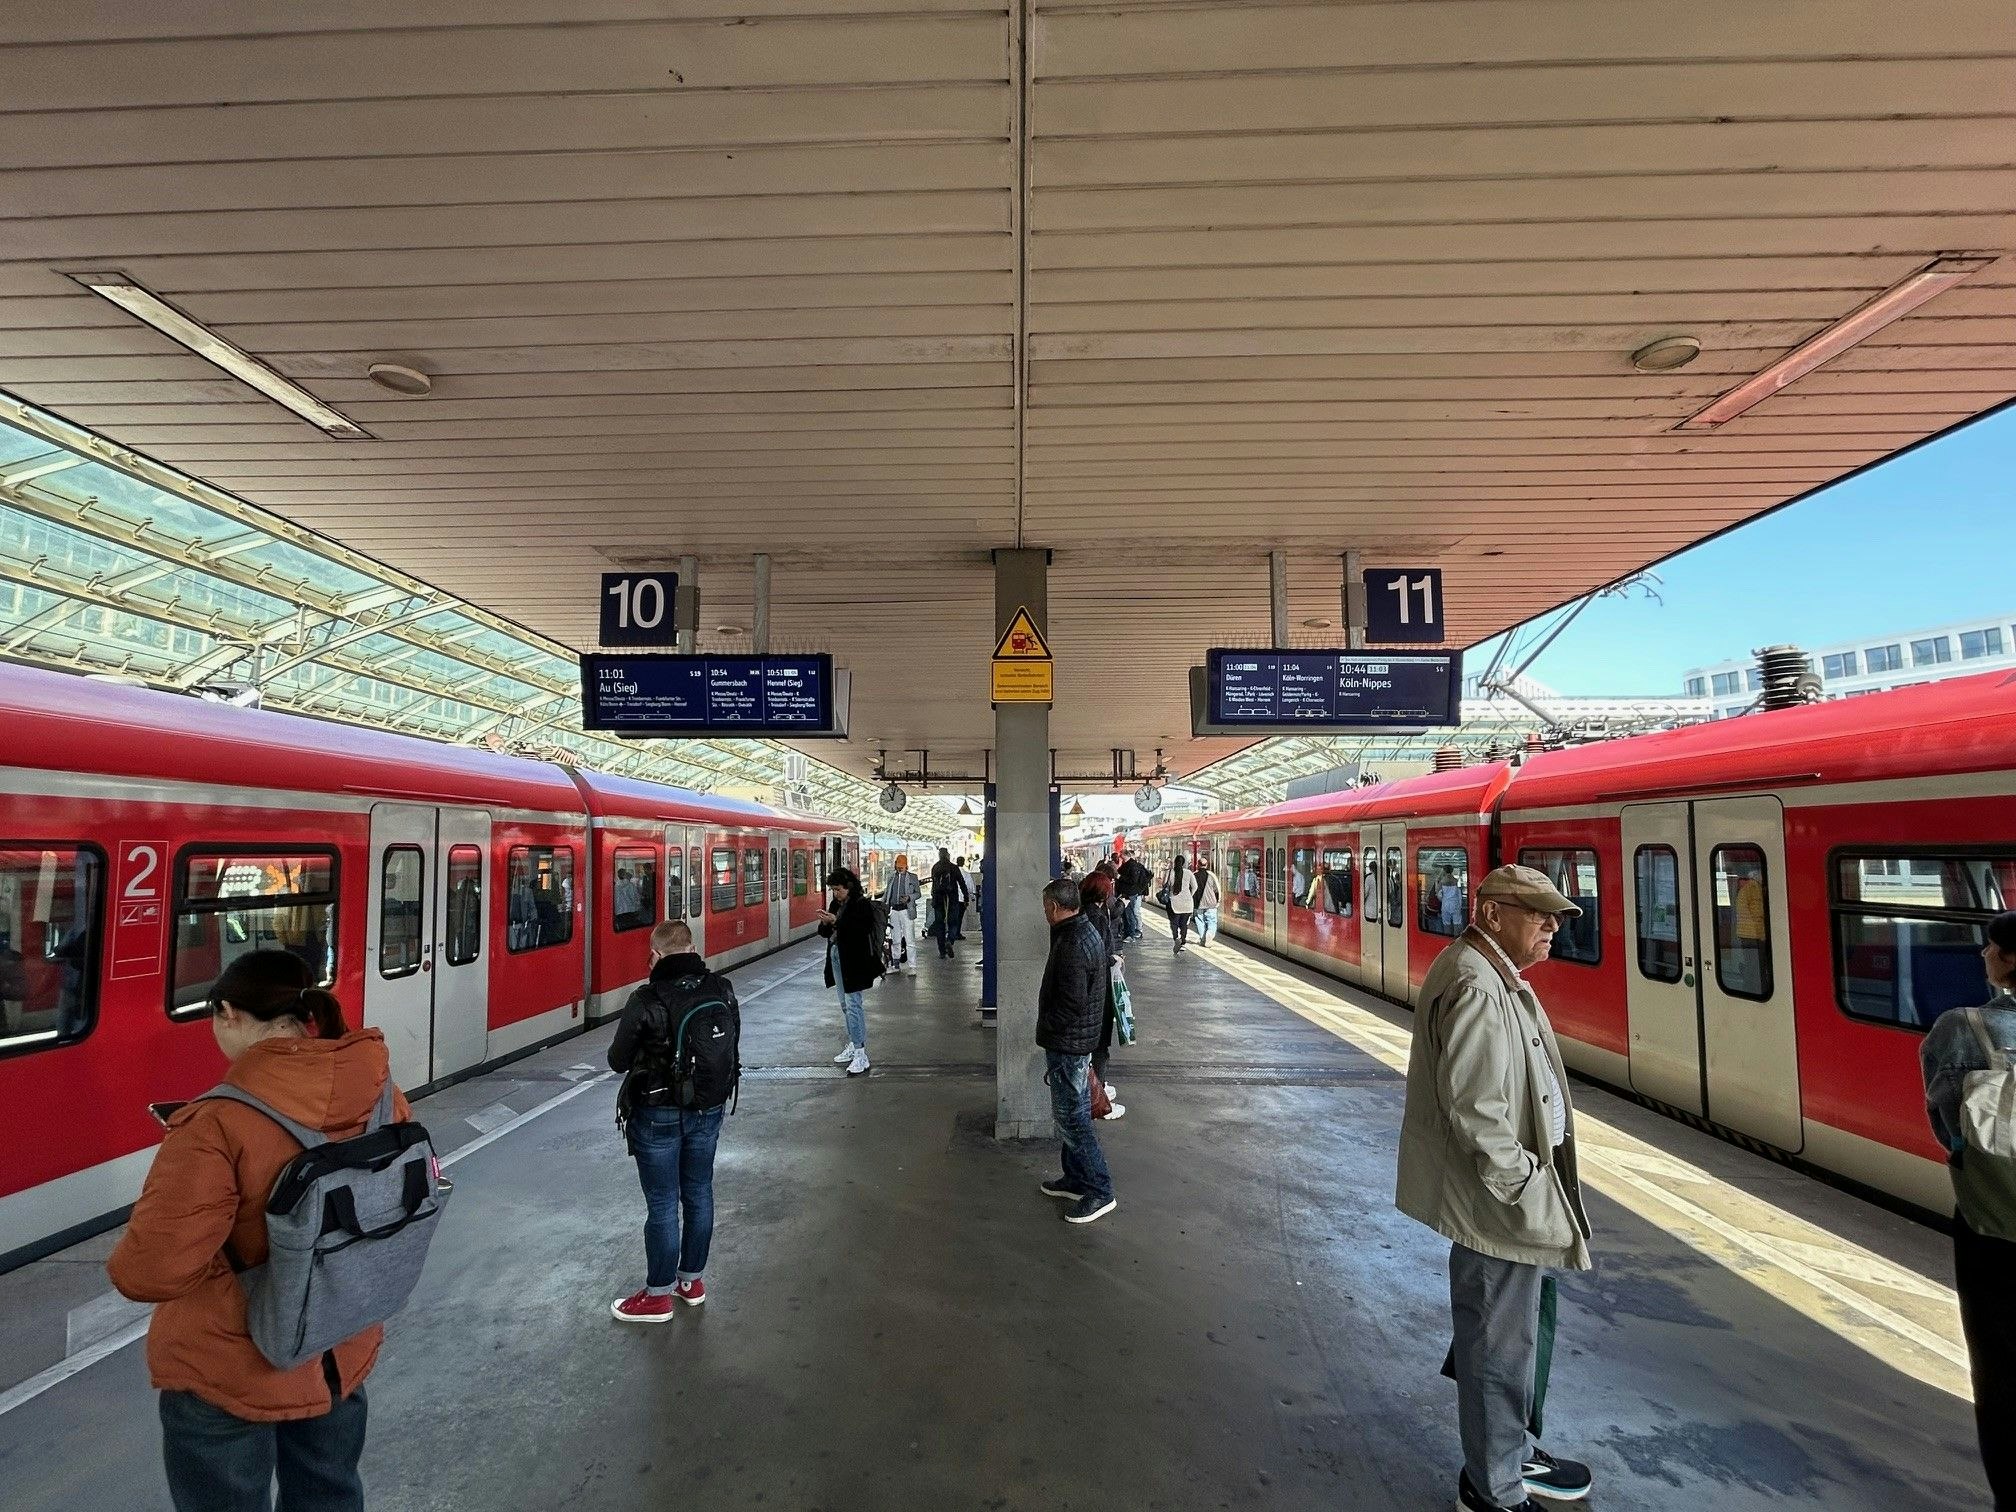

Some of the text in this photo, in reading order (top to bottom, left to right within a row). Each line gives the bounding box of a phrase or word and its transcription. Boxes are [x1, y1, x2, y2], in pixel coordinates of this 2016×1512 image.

[609, 578, 664, 628] 10
[1387, 575, 1433, 624] 11
[711, 668, 728, 676] 10:54
[1226, 663, 1243, 671] 11:00
[1340, 664, 1366, 674] 10:44
[598, 669, 625, 679] 11:01
[1226, 673, 1242, 681] Düren
[1282, 674, 1324, 683] Köln-Worringen
[599, 681, 638, 695] Au (Sieg)
[787, 680, 803, 688] (Sieg)
[1339, 677, 1392, 690] Köln-Nippes
[124, 845, 158, 897] 2
